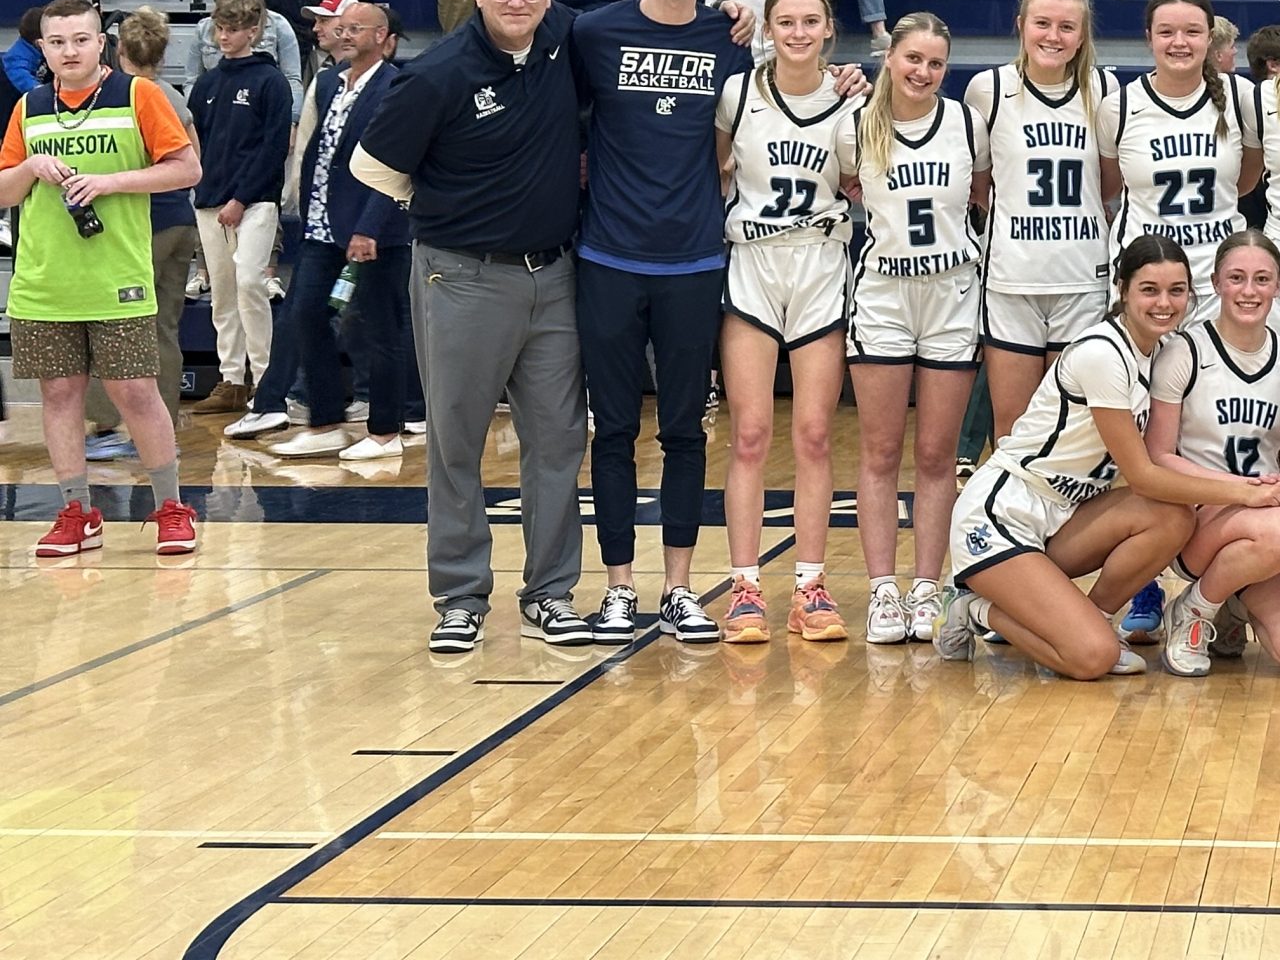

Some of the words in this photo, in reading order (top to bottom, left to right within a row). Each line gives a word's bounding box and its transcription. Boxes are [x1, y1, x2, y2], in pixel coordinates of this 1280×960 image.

[620, 51, 716, 78] SAILOR
[618, 72, 715, 91] BASKETBALL
[1023, 122, 1087, 150] SOUTH
[1149, 133, 1217, 162] SOUTH
[768, 140, 829, 173] SOUTH
[887, 161, 950, 191] SOUTH
[1026, 158, 1084, 208] 30
[1153, 167, 1216, 217] 23
[906, 197, 937, 248] 5
[1010, 216, 1100, 241] CHRISTIAN
[1216, 397, 1278, 430] SOUTH
[1223, 435, 1261, 478] 12
